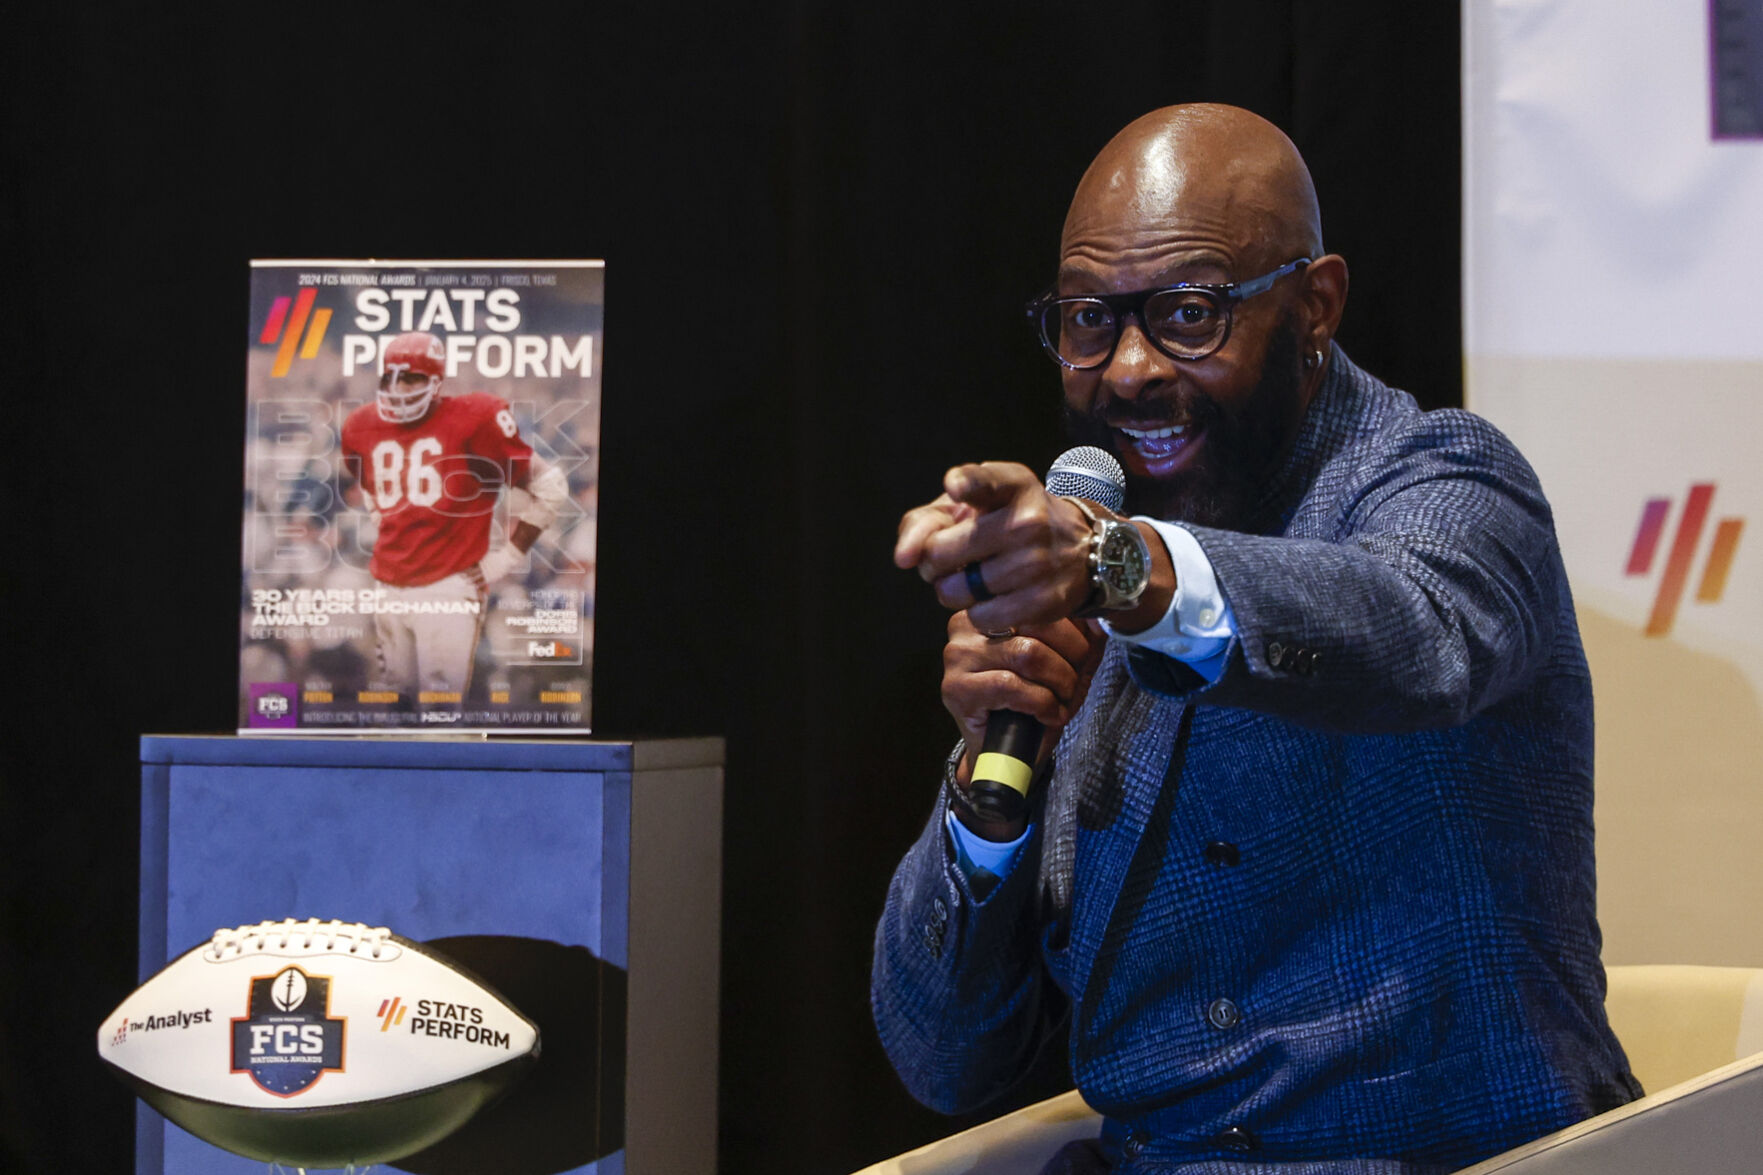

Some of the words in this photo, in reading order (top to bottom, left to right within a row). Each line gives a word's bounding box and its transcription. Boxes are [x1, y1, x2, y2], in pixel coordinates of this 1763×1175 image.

[299, 274, 321, 285] 2024
[322, 274, 338, 285] FCS
[340, 274, 378, 285] NATIONAL
[380, 274, 416, 286] AWARDS
[355, 289, 521, 332] STATS
[343, 335, 593, 378] PFORM
[372, 436, 443, 509] 86
[252, 589, 282, 601] 30
[286, 589, 355, 601] YEARS
[358, 589, 388, 601] OF
[252, 602, 294, 614] THE
[297, 602, 355, 614] BUCK
[358, 602, 480, 614] BUCHANAN
[252, 614, 329, 626] AWARD
[258, 697, 288, 711] FCS
[130, 1022, 145, 1032] The
[145, 1008, 212, 1032] Analyst
[417, 999, 483, 1024] STATS
[250, 1024, 323, 1054] FCS
[411, 1017, 510, 1050] PERFORM
[250, 1056, 289, 1064] NATIONAL
